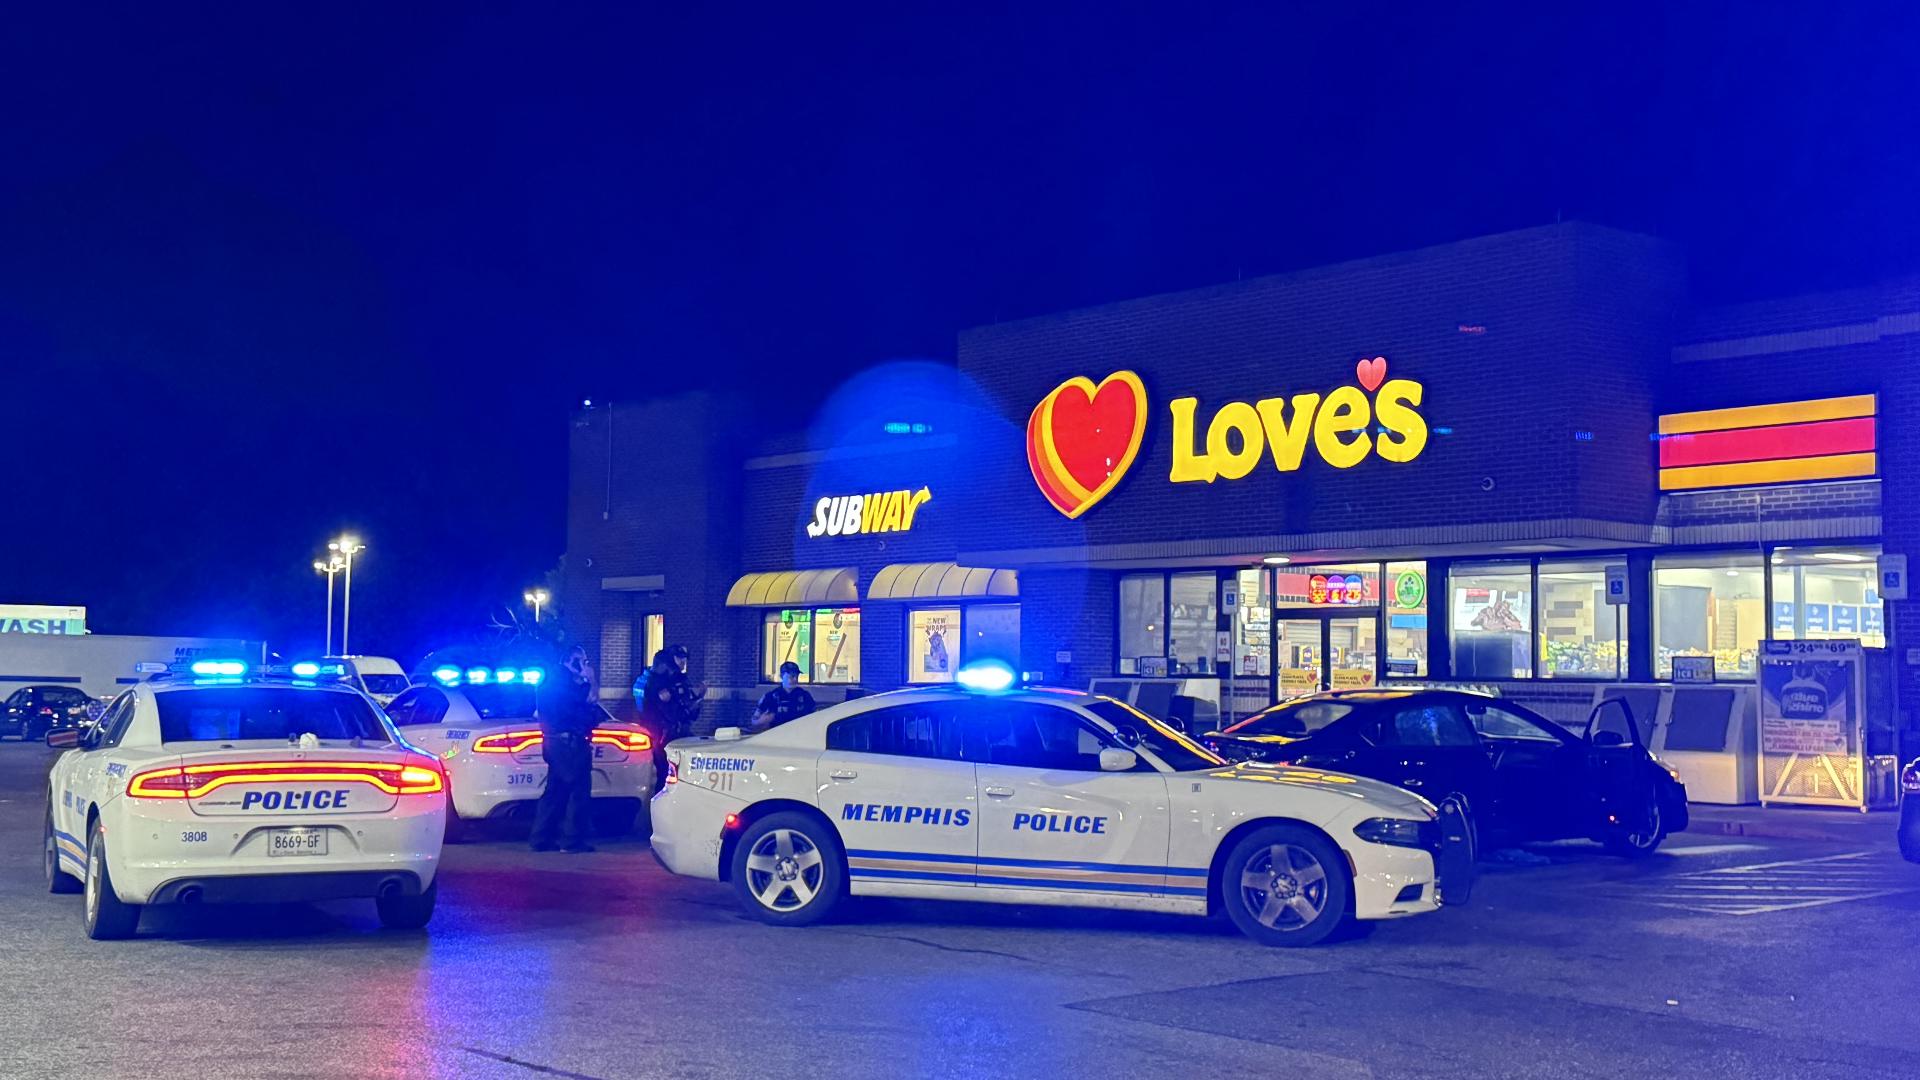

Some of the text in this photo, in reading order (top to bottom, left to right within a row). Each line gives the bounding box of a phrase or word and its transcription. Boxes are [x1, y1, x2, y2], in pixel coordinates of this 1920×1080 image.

[1170, 357, 1427, 483] Love's
[807, 486, 931, 538] SUBWAY
[0, 619, 66, 634] ASH
[691, 756, 755, 771] EMERGENCY
[708, 771, 734, 791] 911
[241, 789, 350, 810] POLICE
[841, 803, 1108, 834] MEMPHIS POLICE
[181, 831, 208, 842] 3808
[274, 834, 321, 849] 8669-GF
